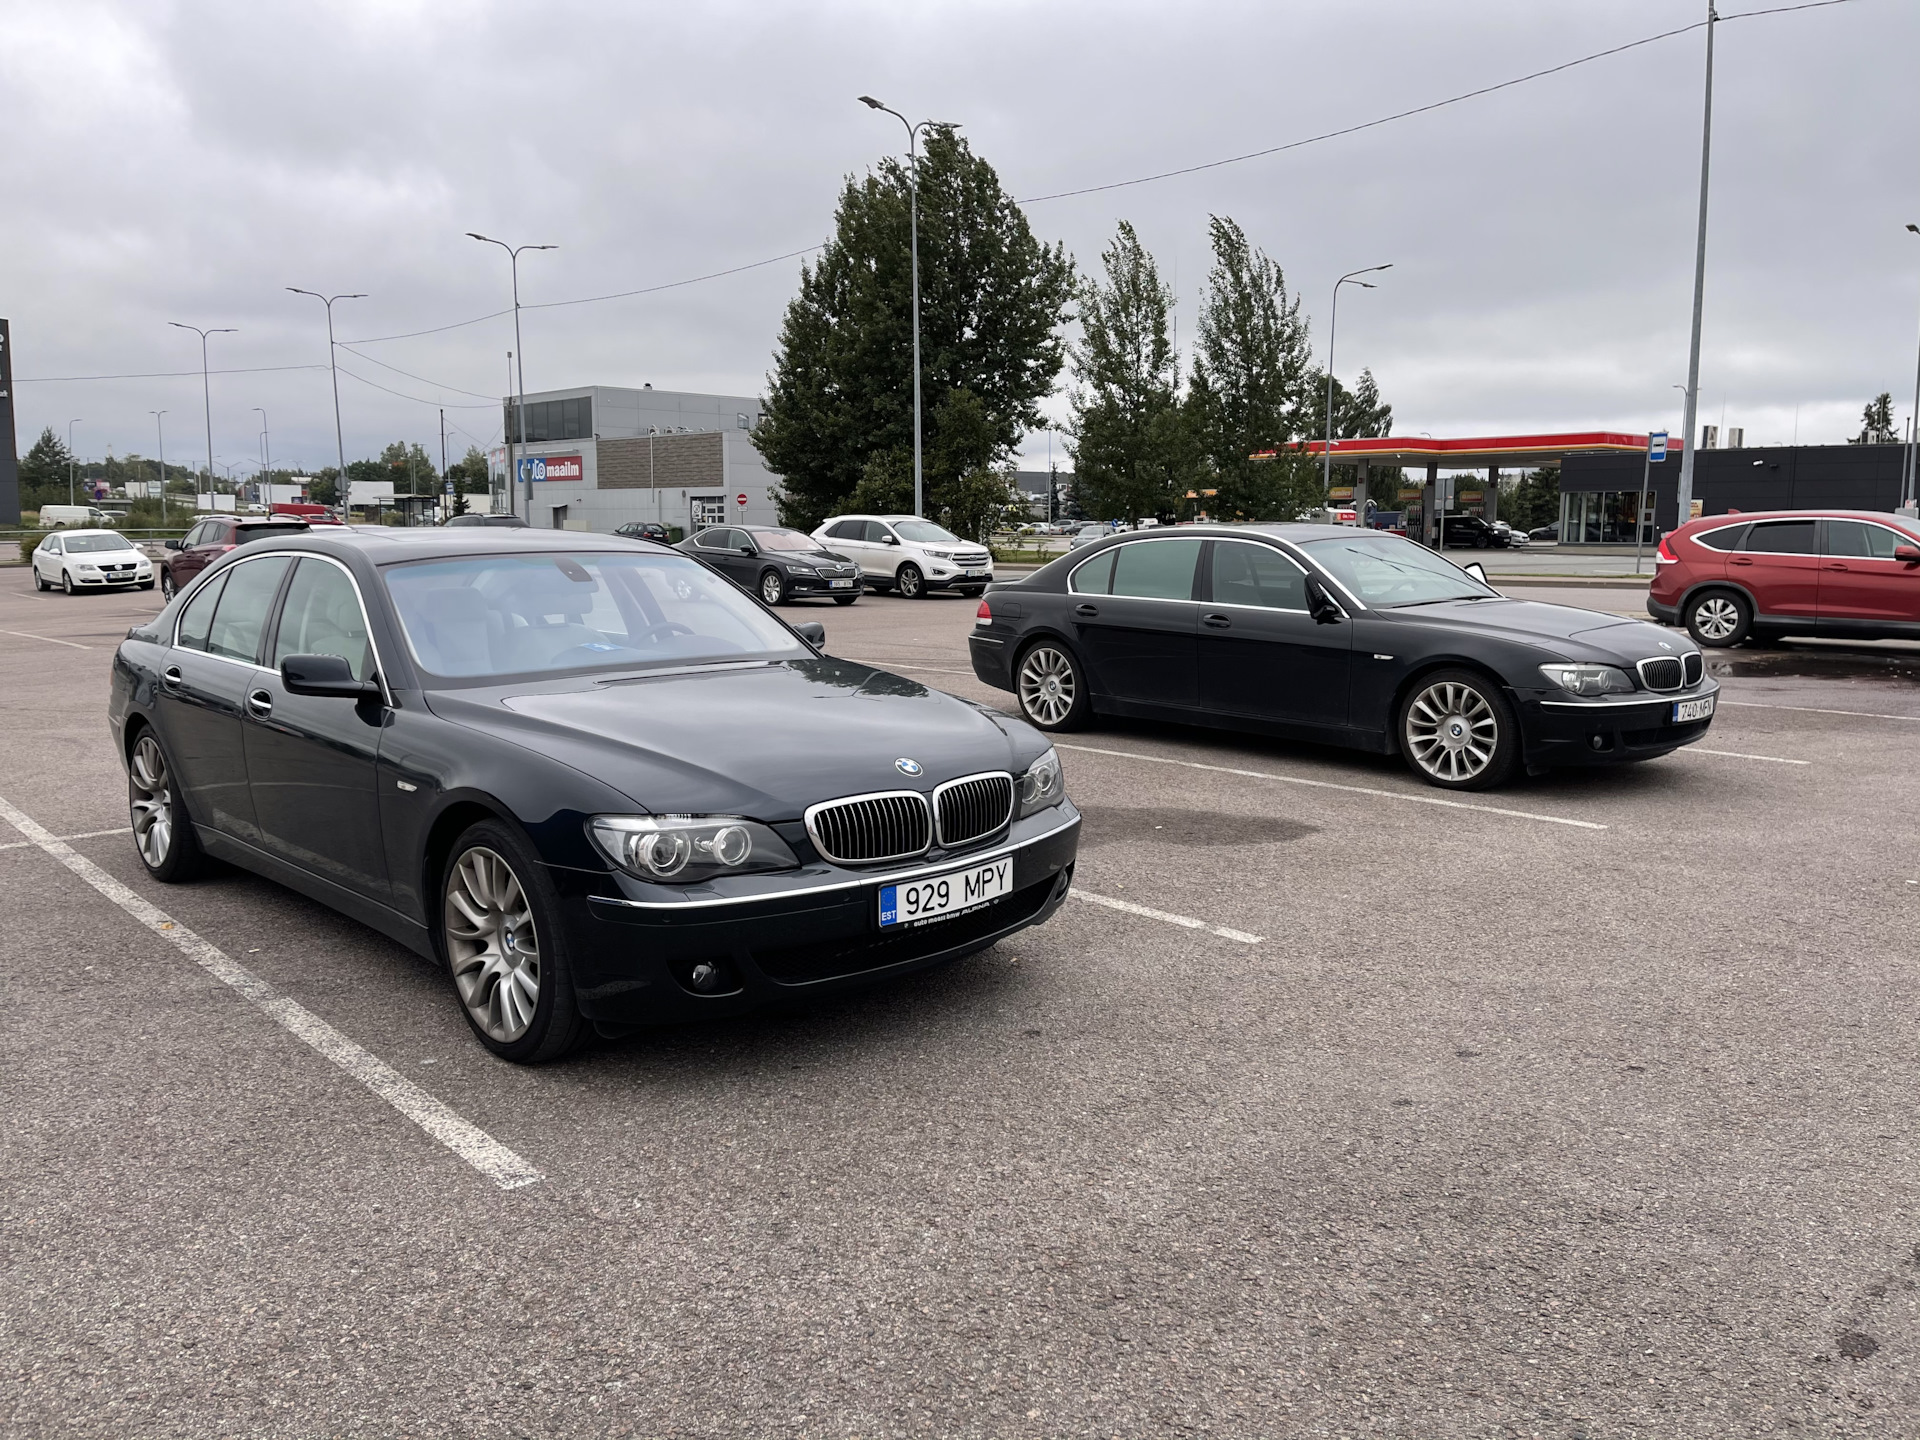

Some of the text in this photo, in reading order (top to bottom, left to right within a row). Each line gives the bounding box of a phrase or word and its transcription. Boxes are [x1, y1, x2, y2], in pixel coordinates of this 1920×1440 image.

[546, 462, 579, 477] maailm
[1682, 702, 1698, 720] 740
[881, 862, 1007, 922] EST 929 MPY
[913, 919, 928, 928] auto
[961, 902, 990, 916] ALPINA
